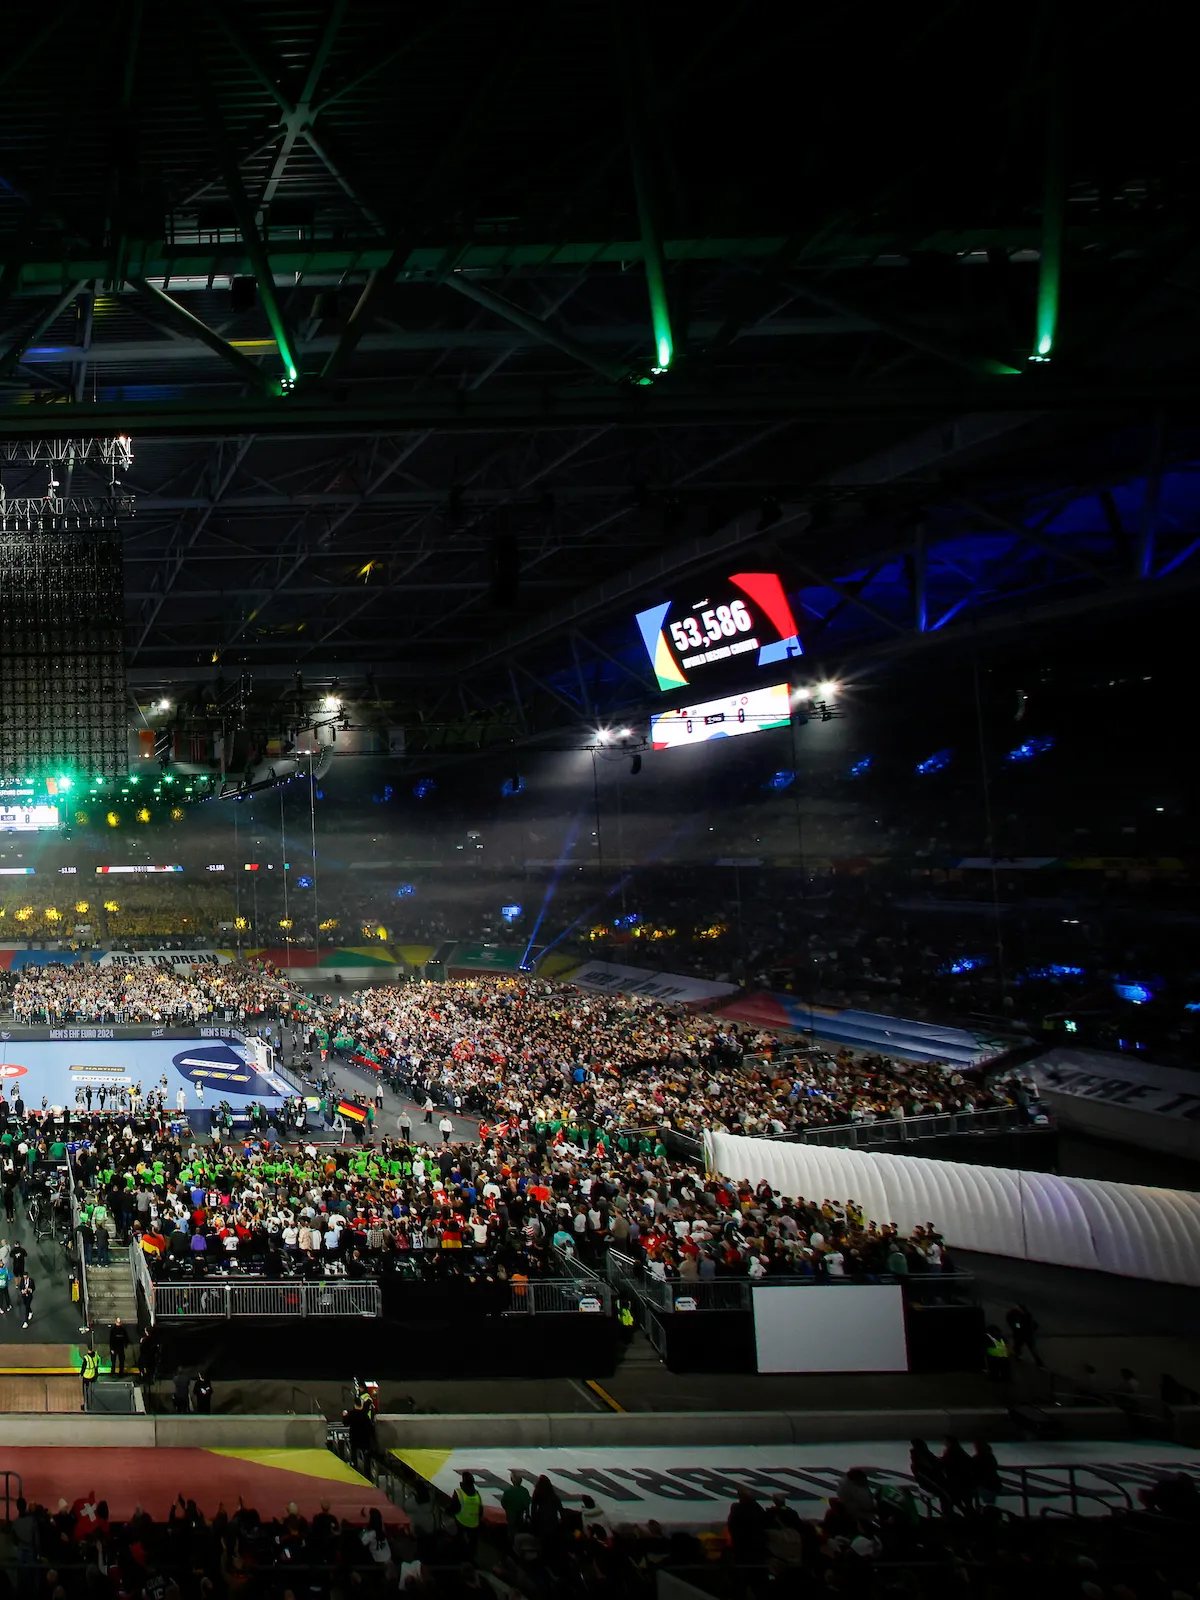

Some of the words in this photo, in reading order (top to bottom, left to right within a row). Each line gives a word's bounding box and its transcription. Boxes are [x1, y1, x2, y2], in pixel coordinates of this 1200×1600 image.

[669, 600, 752, 651] 53,586
[111, 955, 145, 967] HERE
[171, 954, 219, 966] DREAM
[69, 1029, 80, 1038] EHF
[81, 1029, 97, 1038] EURO
[97, 1029, 114, 1038] 2024
[220, 1028, 231, 1038] EHF
